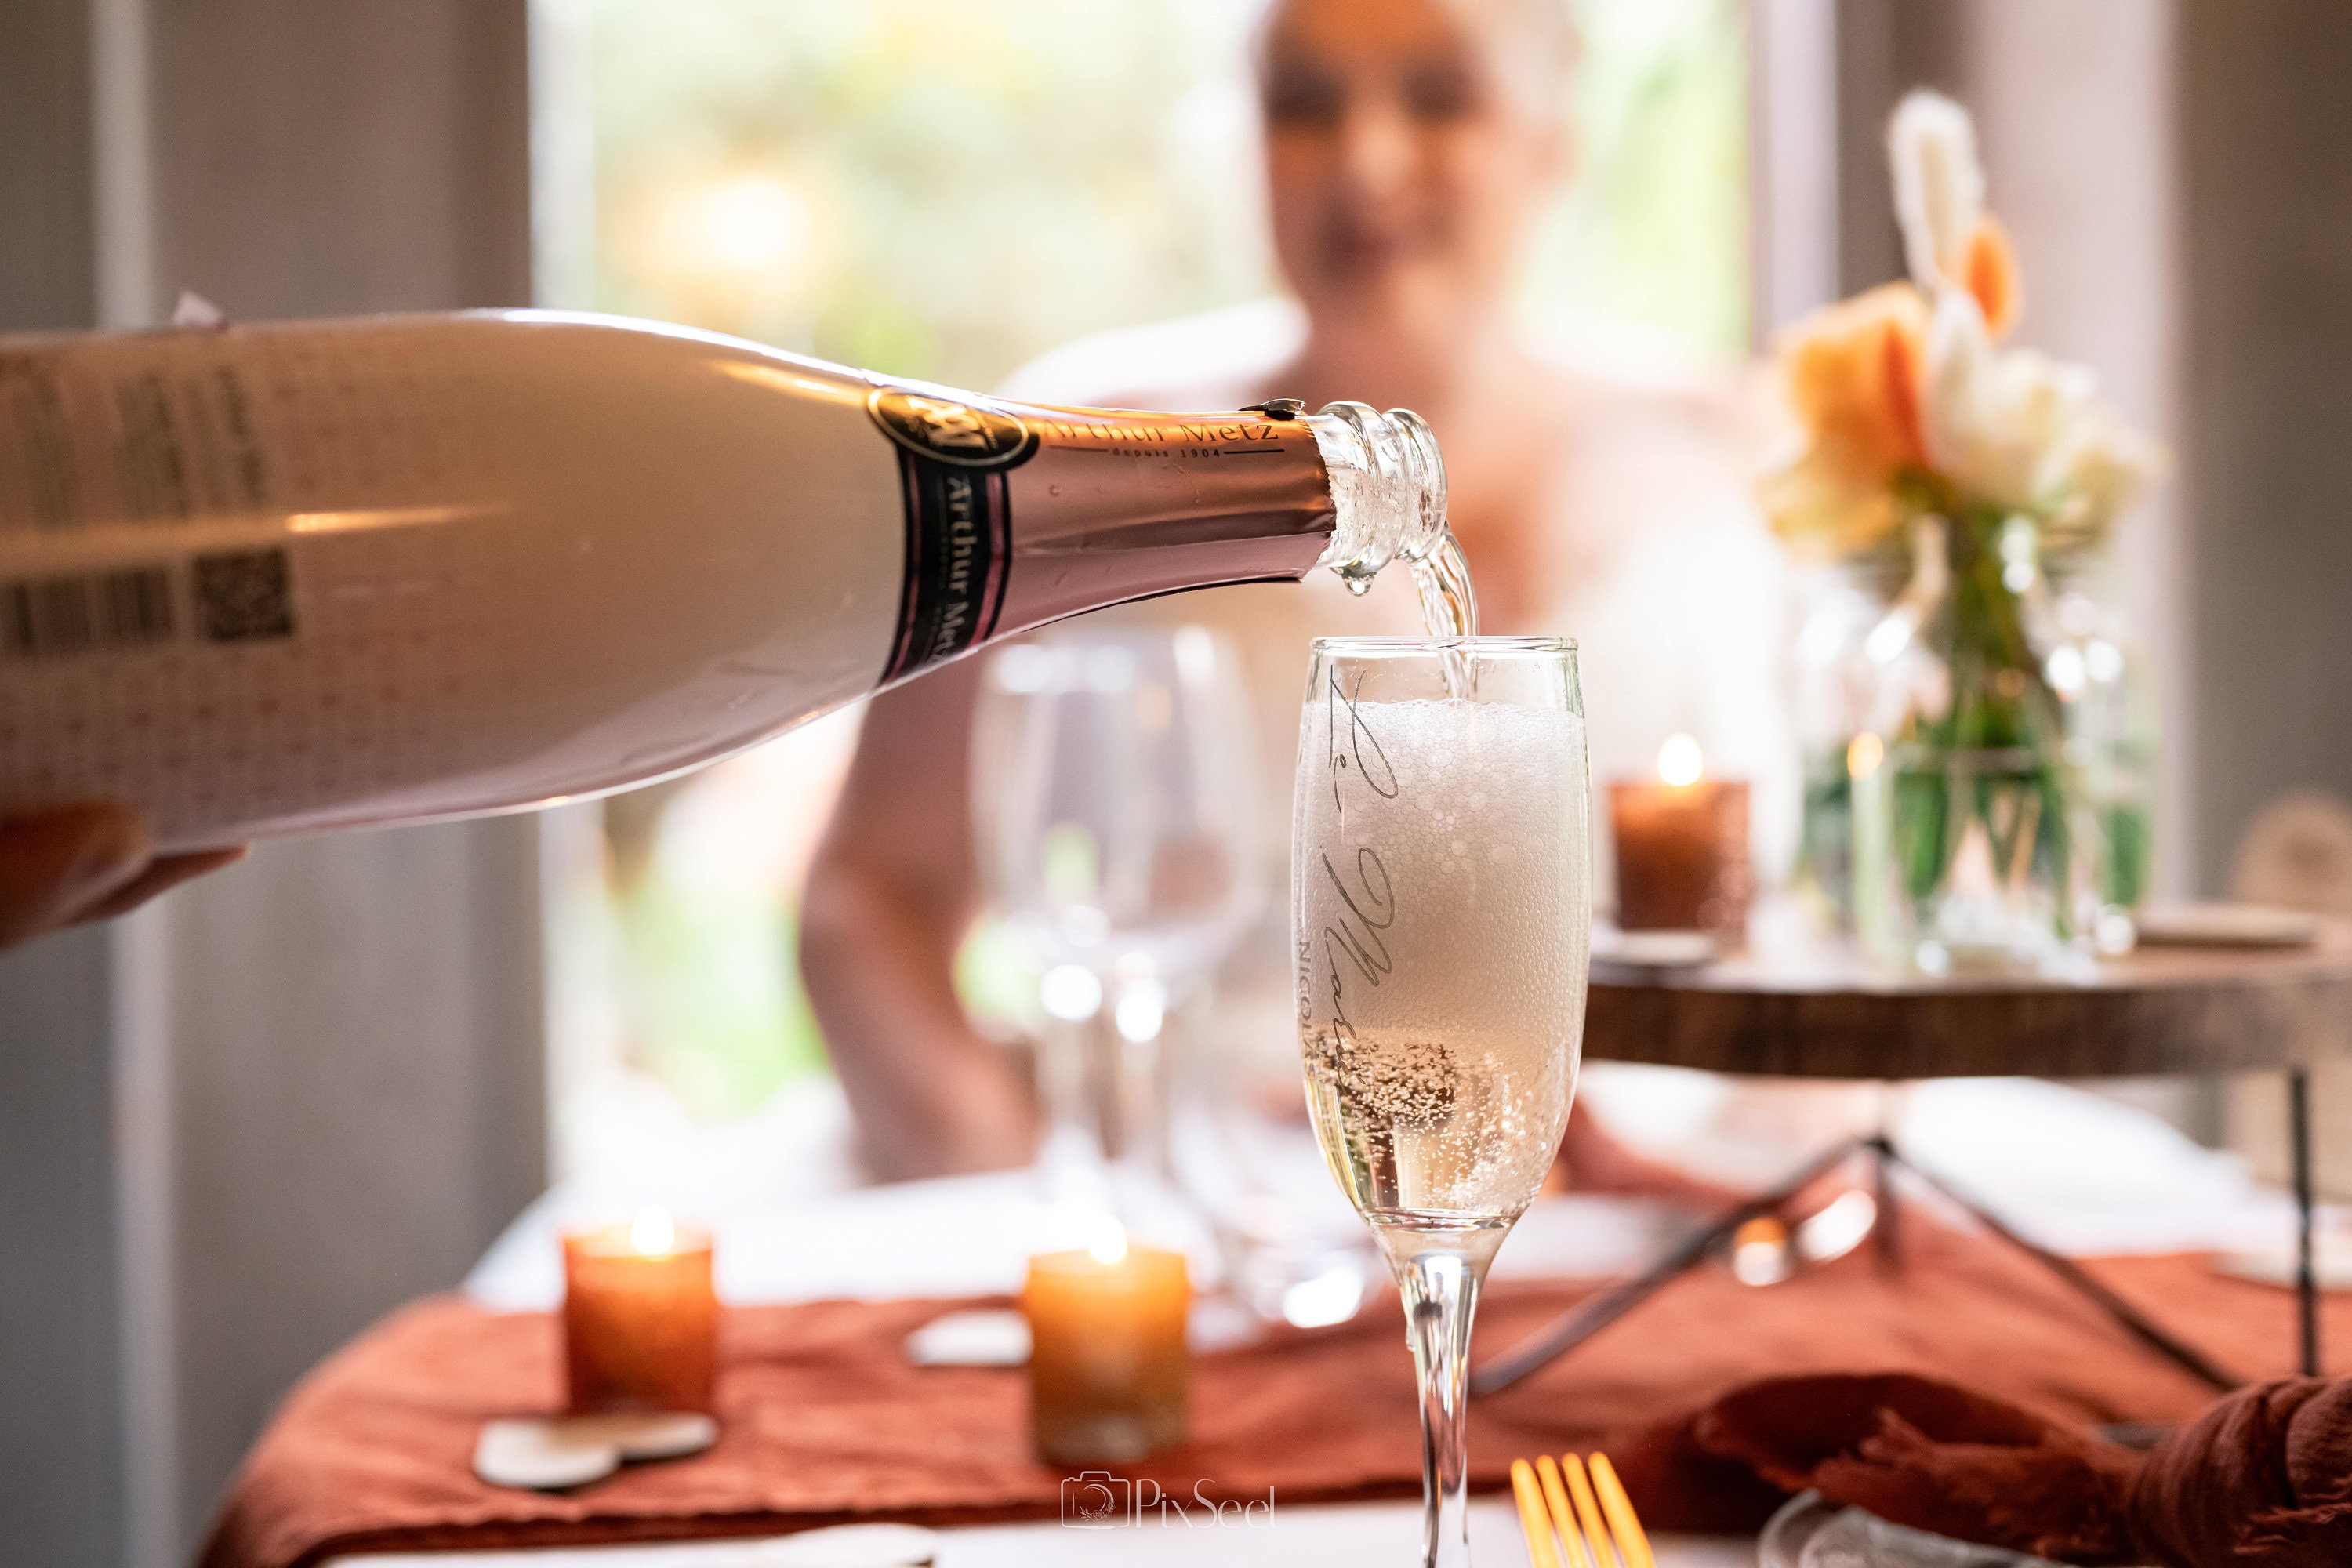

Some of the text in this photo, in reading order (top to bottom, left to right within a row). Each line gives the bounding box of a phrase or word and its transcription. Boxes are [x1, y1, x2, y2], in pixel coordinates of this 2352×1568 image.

[1044, 419, 1279, 442] Arthur Metz
[1112, 448, 1220, 459] depuis 1904
[946, 477, 978, 594] Arthur
[1329, 665, 1398, 813] Le
